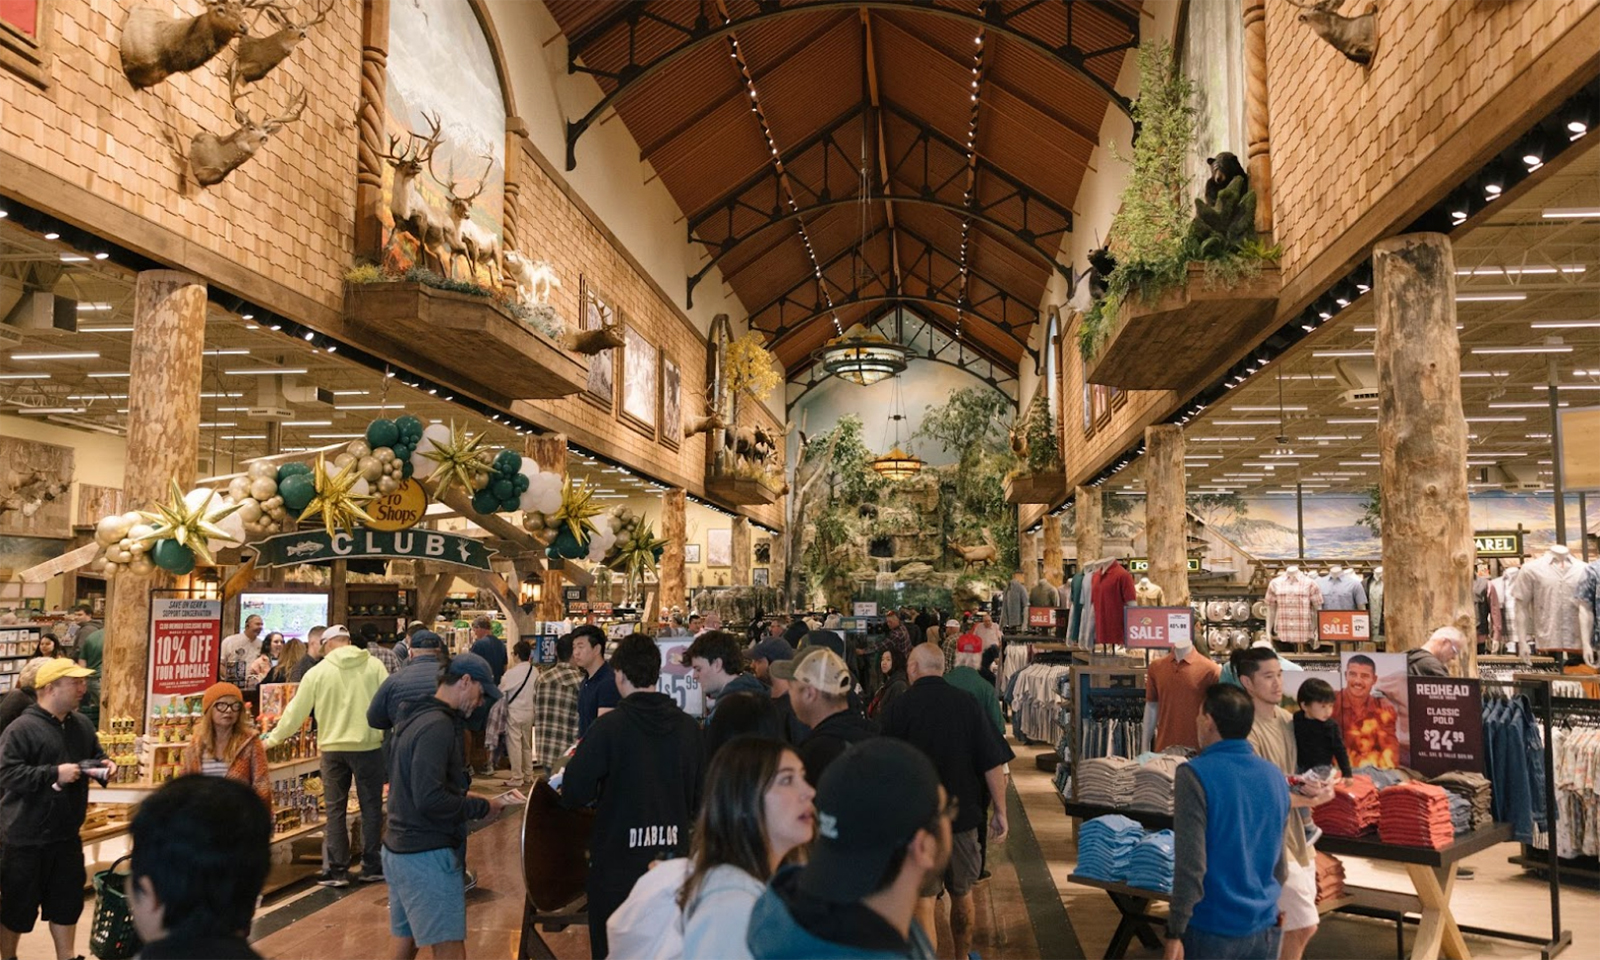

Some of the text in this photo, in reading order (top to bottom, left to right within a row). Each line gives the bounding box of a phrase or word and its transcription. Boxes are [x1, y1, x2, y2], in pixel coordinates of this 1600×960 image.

[376, 504, 417, 525] Shops
[331, 532, 445, 555] CLUB
[1475, 538, 1512, 551] AREL
[169, 601, 181, 609] SAVE
[1030, 615, 1048, 623] SALE
[1129, 626, 1164, 639] SALE
[1322, 624, 1349, 635] SALE
[157, 635, 213, 664] 10% OFF
[541, 640, 555, 656] $50
[156, 663, 210, 680] YOUR PURCHASE
[1416, 684, 1470, 697] REDHEAD
[1426, 707, 1460, 716] CLASSIC
[1433, 716, 1454, 725] POLO
[629, 825, 678, 848] DIABLOS
